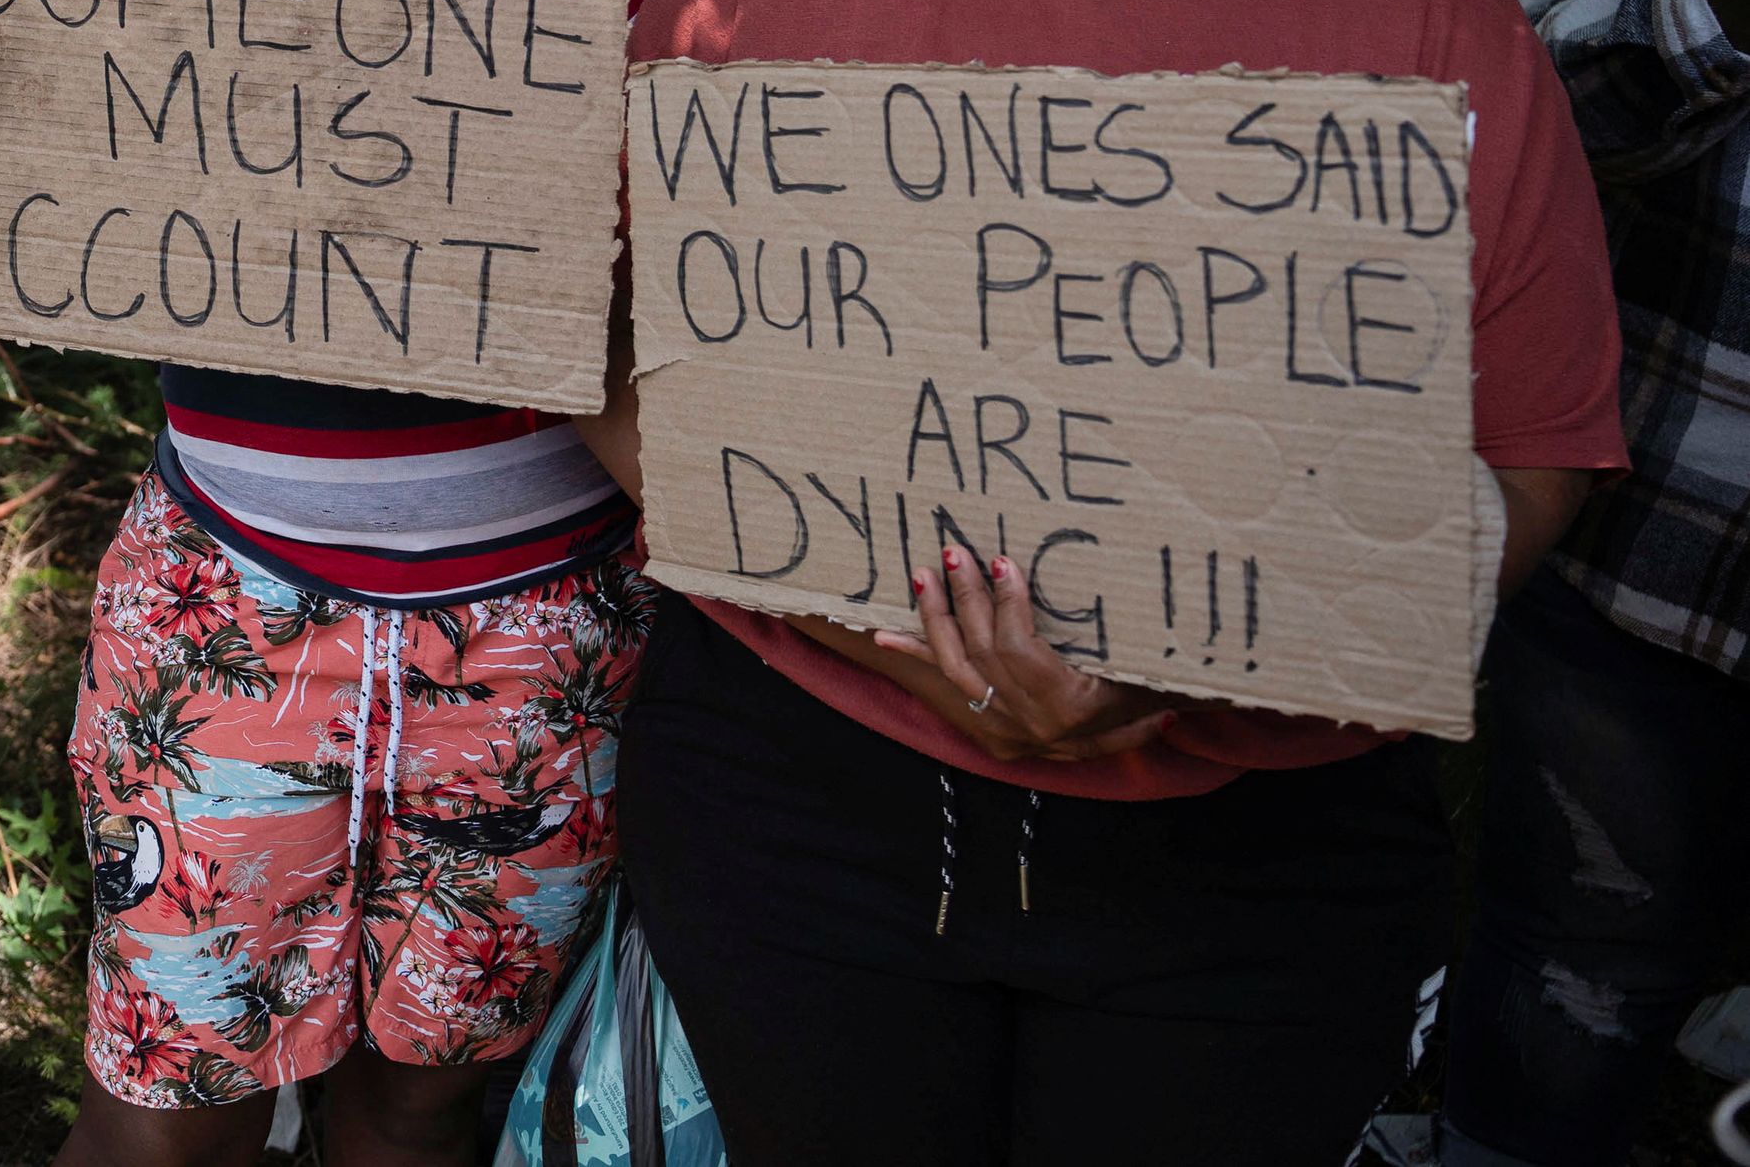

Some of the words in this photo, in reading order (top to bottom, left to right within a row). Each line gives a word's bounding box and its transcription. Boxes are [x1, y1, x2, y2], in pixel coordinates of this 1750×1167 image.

[103, 49, 513, 205] MUST
[649, 79, 848, 206] WE
[881, 81, 1175, 210] ONES
[1215, 101, 1460, 237] SAID
[675, 228, 894, 357] OUR
[974, 222, 1423, 393] PEOPLE
[905, 377, 1133, 505] ARE
